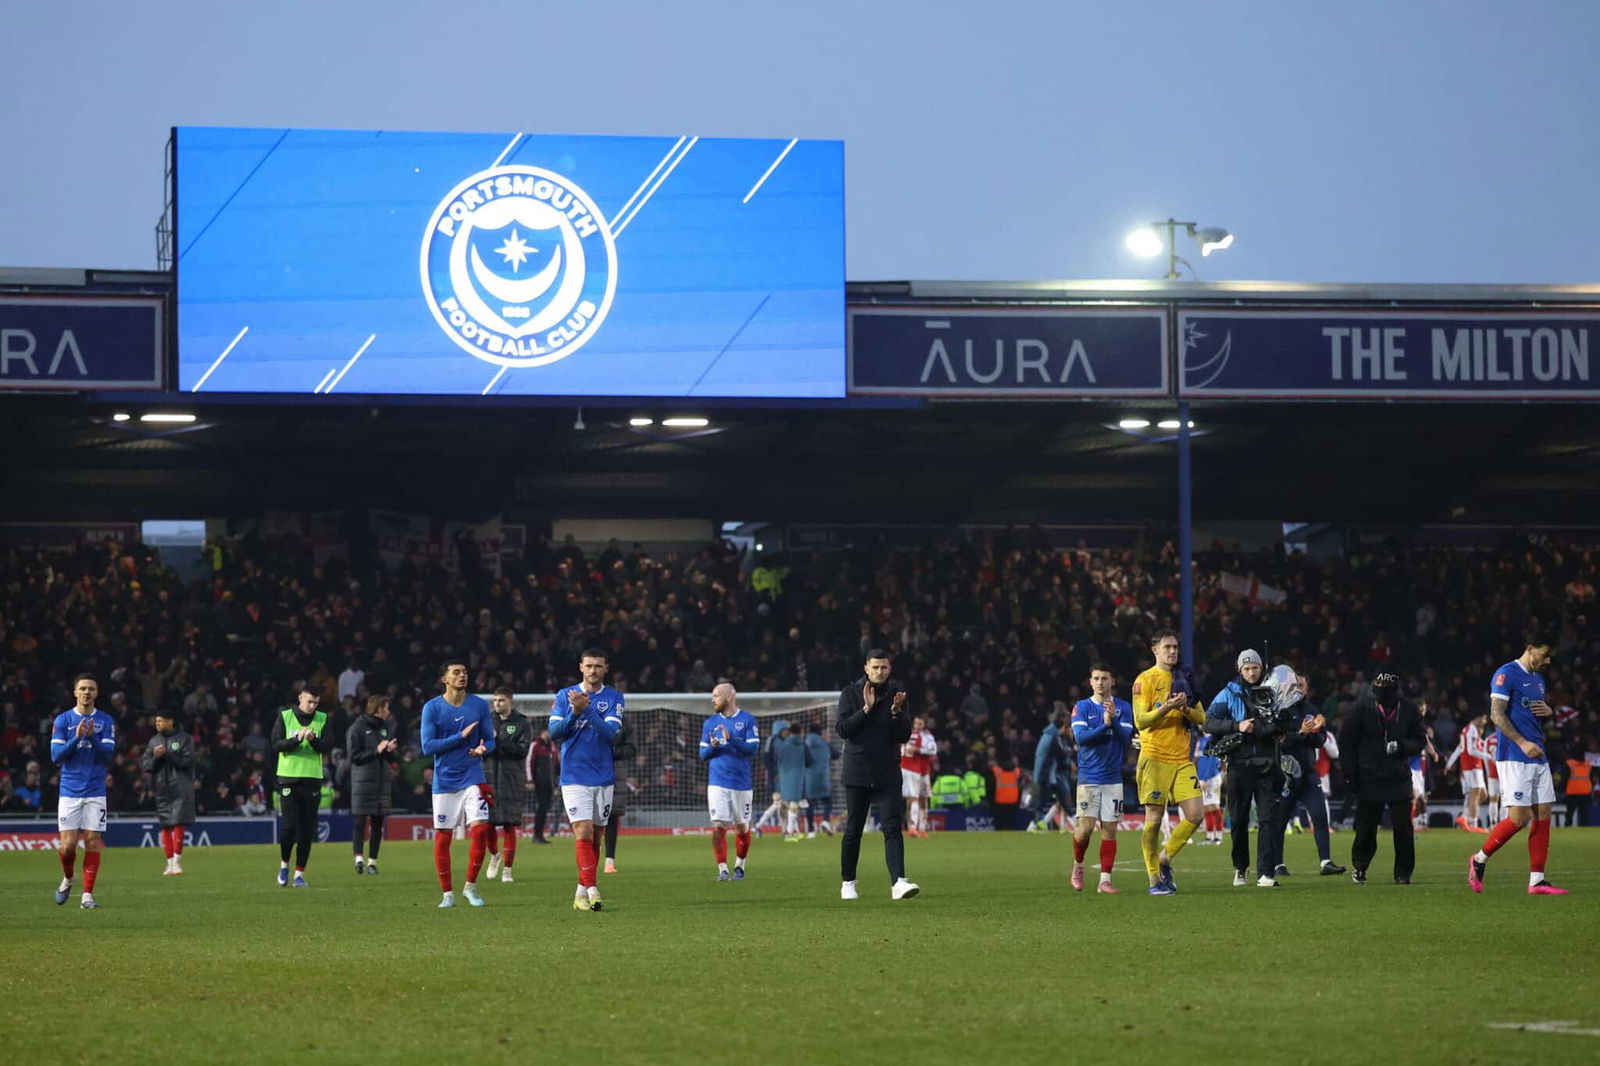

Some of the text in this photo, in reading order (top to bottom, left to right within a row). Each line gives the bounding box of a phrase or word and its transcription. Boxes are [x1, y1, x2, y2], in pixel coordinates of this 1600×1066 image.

[437, 175, 598, 238] PORTSMOUTH
[441, 297, 596, 356] FOOTBALL CLUB
[1322, 327, 1590, 382] THE MILTON
[99, 809, 106, 823] 2
[603, 804, 611, 818] 8
